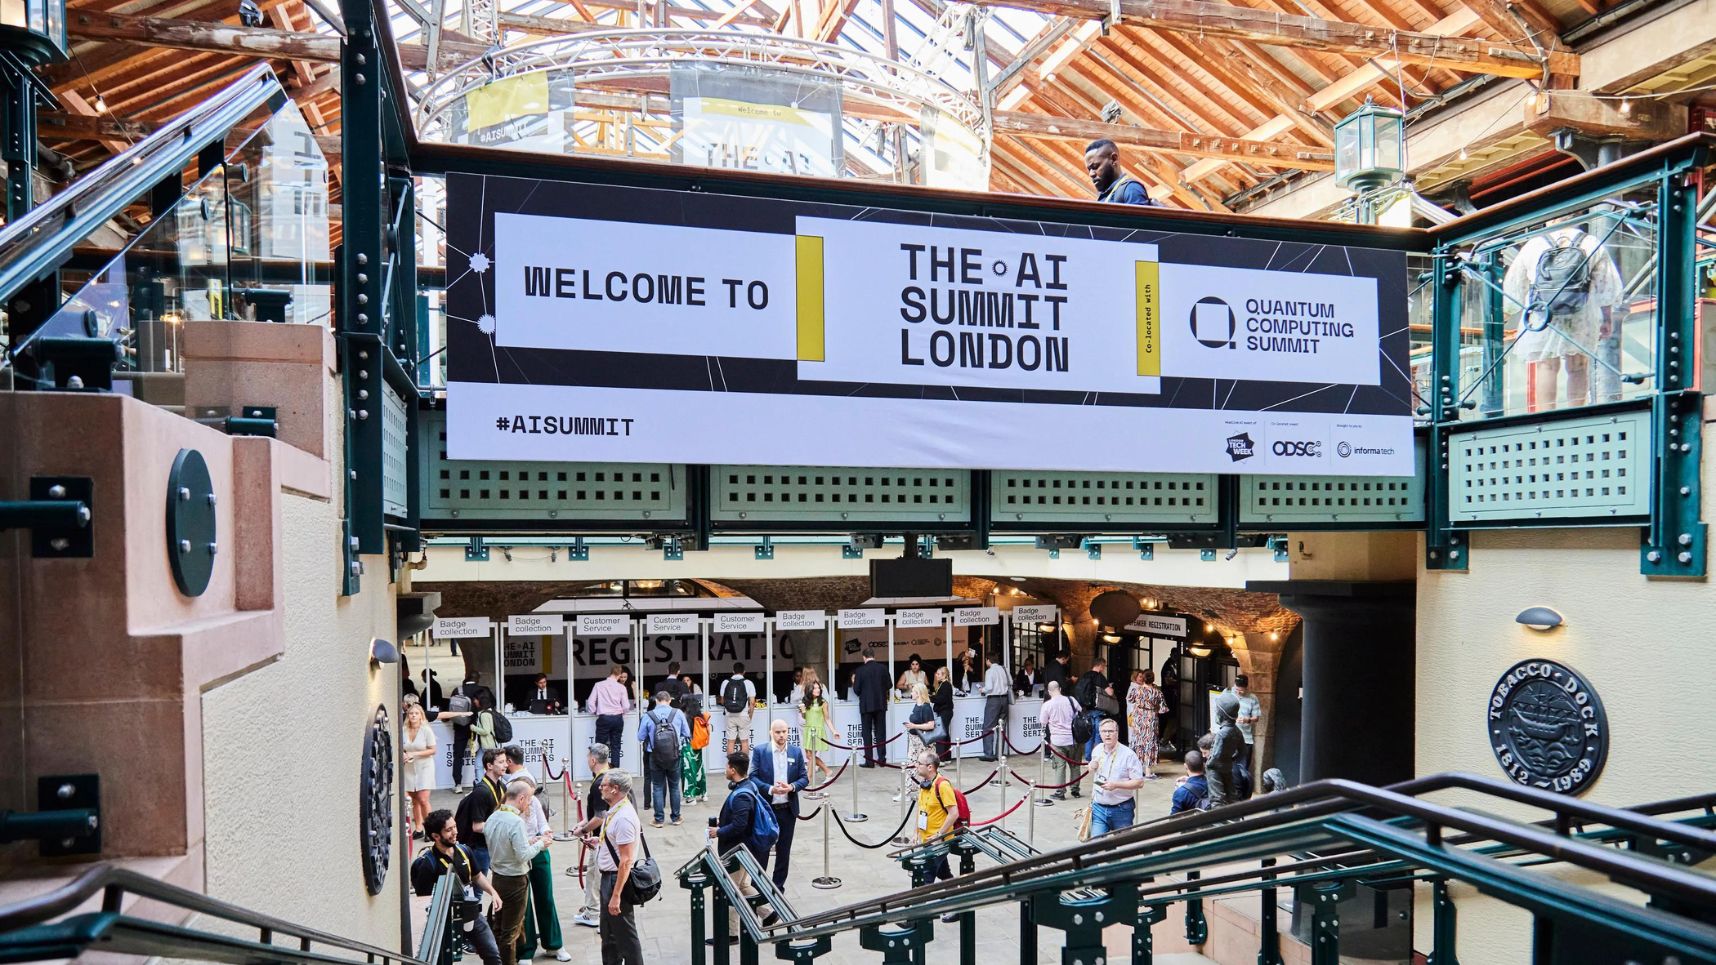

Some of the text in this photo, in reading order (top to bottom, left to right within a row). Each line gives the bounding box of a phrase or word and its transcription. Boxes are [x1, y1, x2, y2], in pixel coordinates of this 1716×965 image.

[900, 243, 1068, 290] THE AI
[524, 265, 769, 310] WELCOME TO
[900, 286, 1068, 331] SUMMIT
[1246, 298, 1335, 318] QUANTUM
[1246, 318, 1354, 338] COMPUTING
[901, 328, 1069, 372] LONDON
[1246, 336, 1320, 354] SUMMIT
[496, 415, 635, 436] #AISUMMIT
[1272, 441, 1321, 457] ODSC
[515, 617, 541, 625] Badge
[583, 617, 620, 625] Customer
[653, 616, 689, 624] Customer
[782, 613, 805, 621] Badge
[844, 611, 866, 619] Badge
[902, 611, 924, 619] Badge
[440, 620, 466, 628] Badge
[1149, 621, 1181, 631] REGISTRATION
[440, 627, 478, 636] collection
[522, 642, 535, 650] AI
[573, 632, 794, 666] REGISTRATIO
[504, 650, 535, 658] UMMIT
[504, 658, 535, 667] ONDON
[1490, 663, 1599, 737] TOBACCO DOCK
[1496, 744, 1591, 792] 1812 1989
